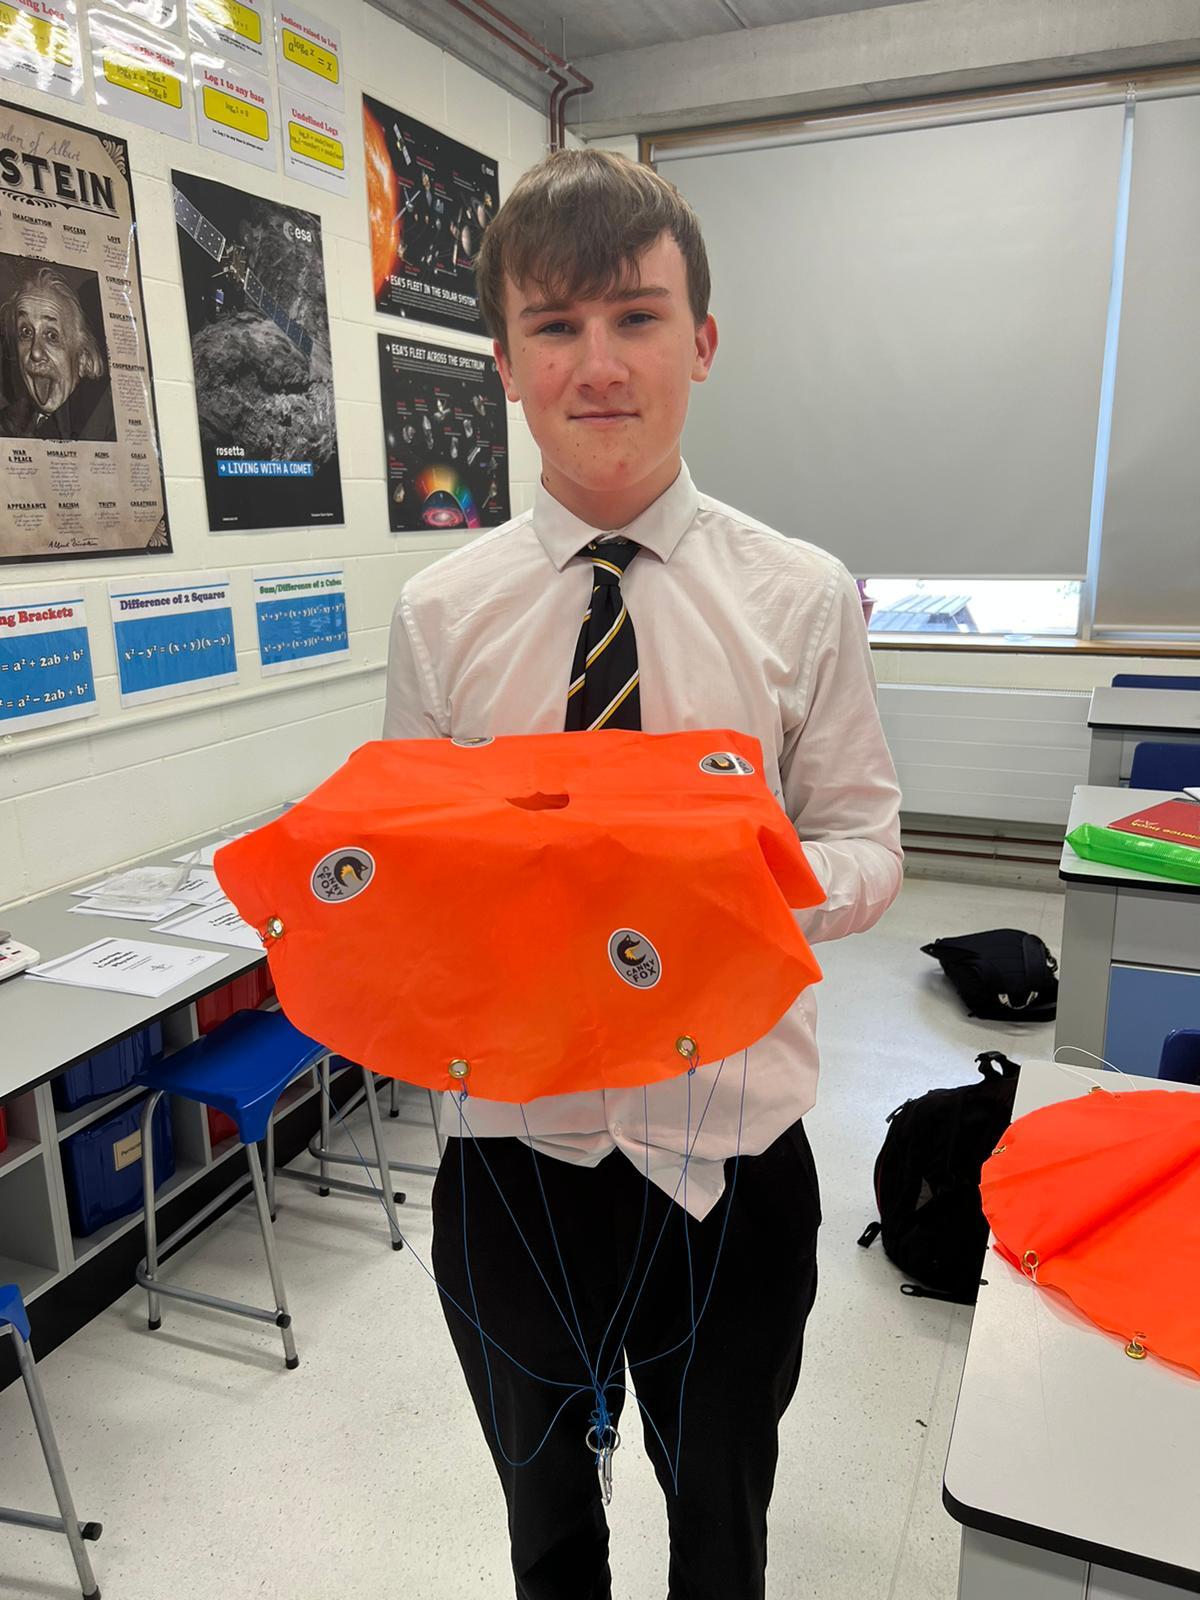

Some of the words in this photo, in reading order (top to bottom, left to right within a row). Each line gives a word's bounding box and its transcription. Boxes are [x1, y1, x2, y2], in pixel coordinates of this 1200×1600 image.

[204, 70, 219, 86] Log
[226, 80, 234, 91] to
[292, 108, 324, 129] Undefined
[0, 148, 117, 211] STEIN
[12, 212, 52, 228] IMAGINATION
[63, 224, 87, 236] SUCCESS
[295, 227, 312, 243] esa
[390, 275, 406, 288] ESA'S
[407, 279, 423, 292] FLEET
[391, 344, 408, 357] ESA'S
[409, 347, 426, 360] FLEET
[427, 351, 447, 364] ACROSS
[216, 446, 245, 456] rosetta
[228, 463, 259, 474] LIVING
[260, 463, 283, 474] WITH
[284, 464, 289, 473] A
[289, 463, 311, 474] COMET
[120, 598, 171, 610] Difference
[172, 594, 183, 604] of
[184, 594, 190, 603] 2
[191, 591, 225, 603] Squares
[18, 607, 73, 623] Brackets
[317, 872, 336, 898] FOX
[322, 865, 344, 896] CANNY
[626, 959, 655, 977] CANNY
[632, 966, 657, 983] FOX
